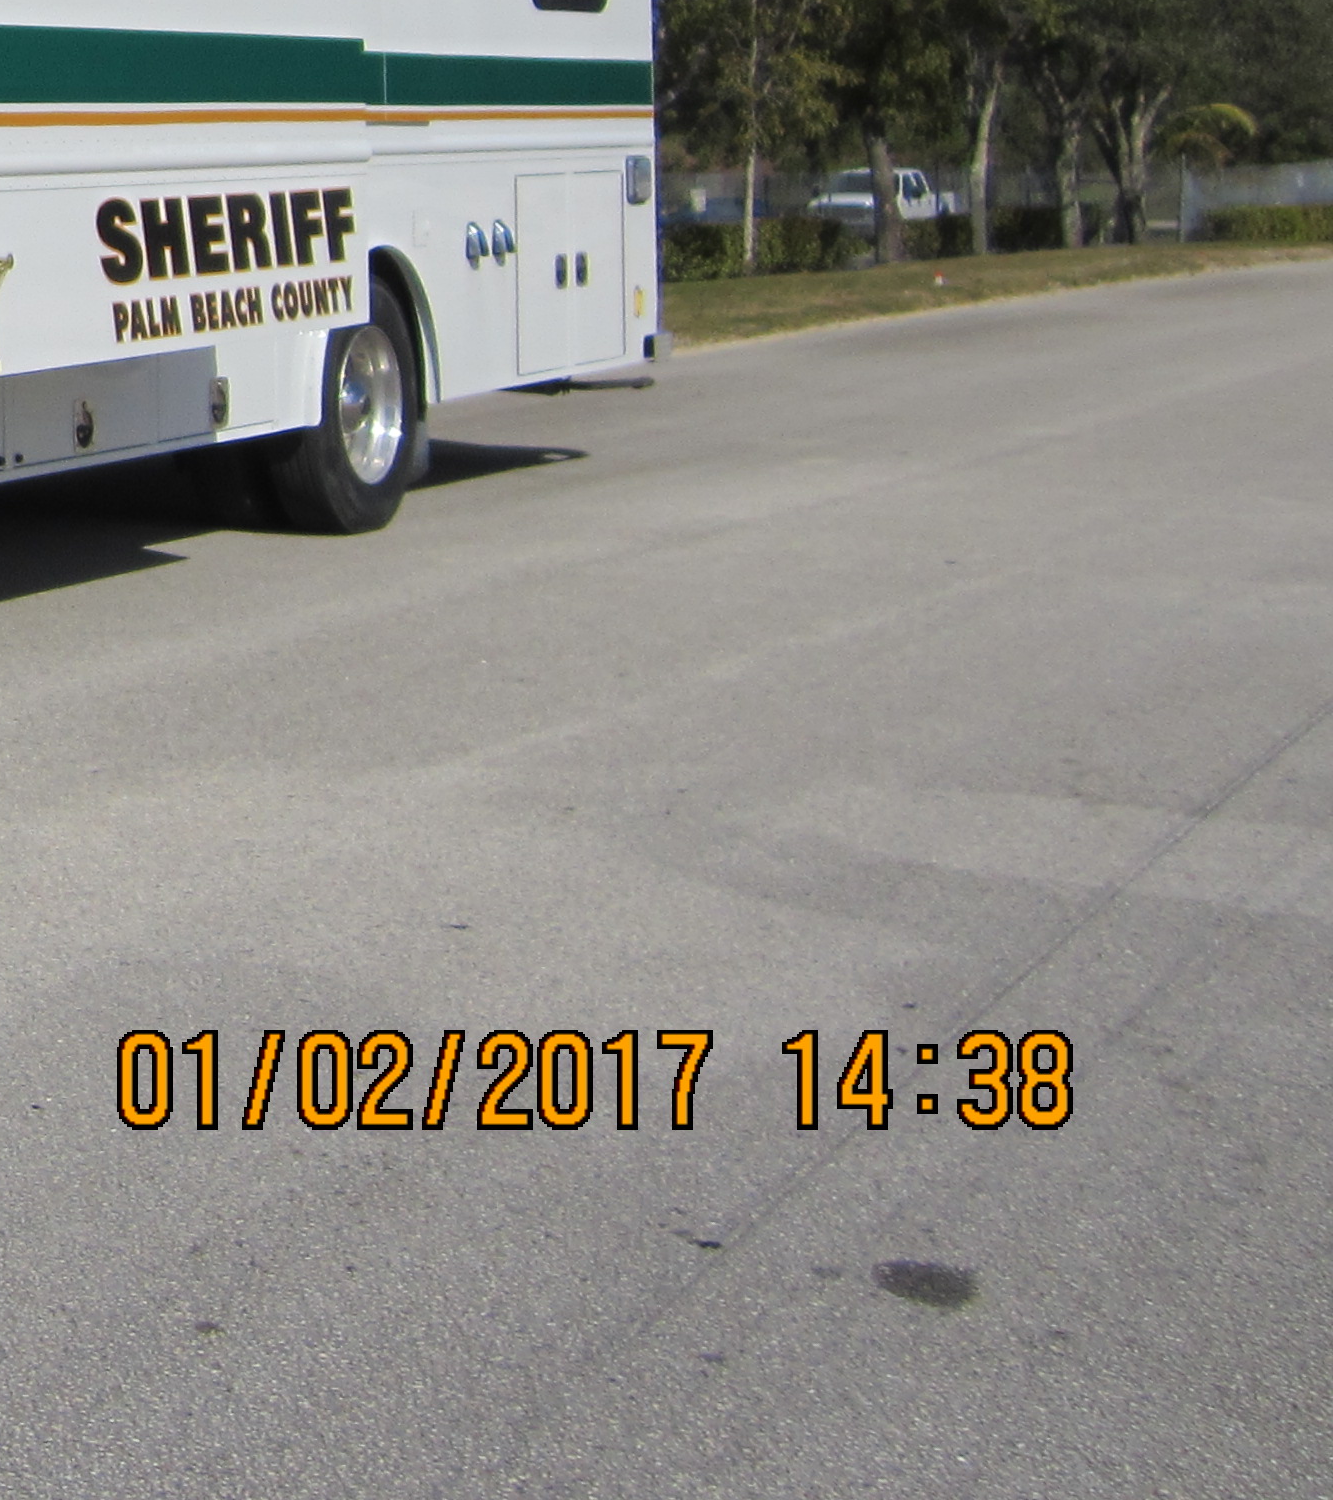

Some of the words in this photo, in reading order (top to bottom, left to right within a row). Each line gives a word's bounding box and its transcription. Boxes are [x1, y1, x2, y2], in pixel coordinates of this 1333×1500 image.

[96, 187, 356, 285] SHERIFF
[112, 296, 182, 343] PALM
[189, 286, 265, 333] BEACH
[271, 276, 353, 322] COUNTY
